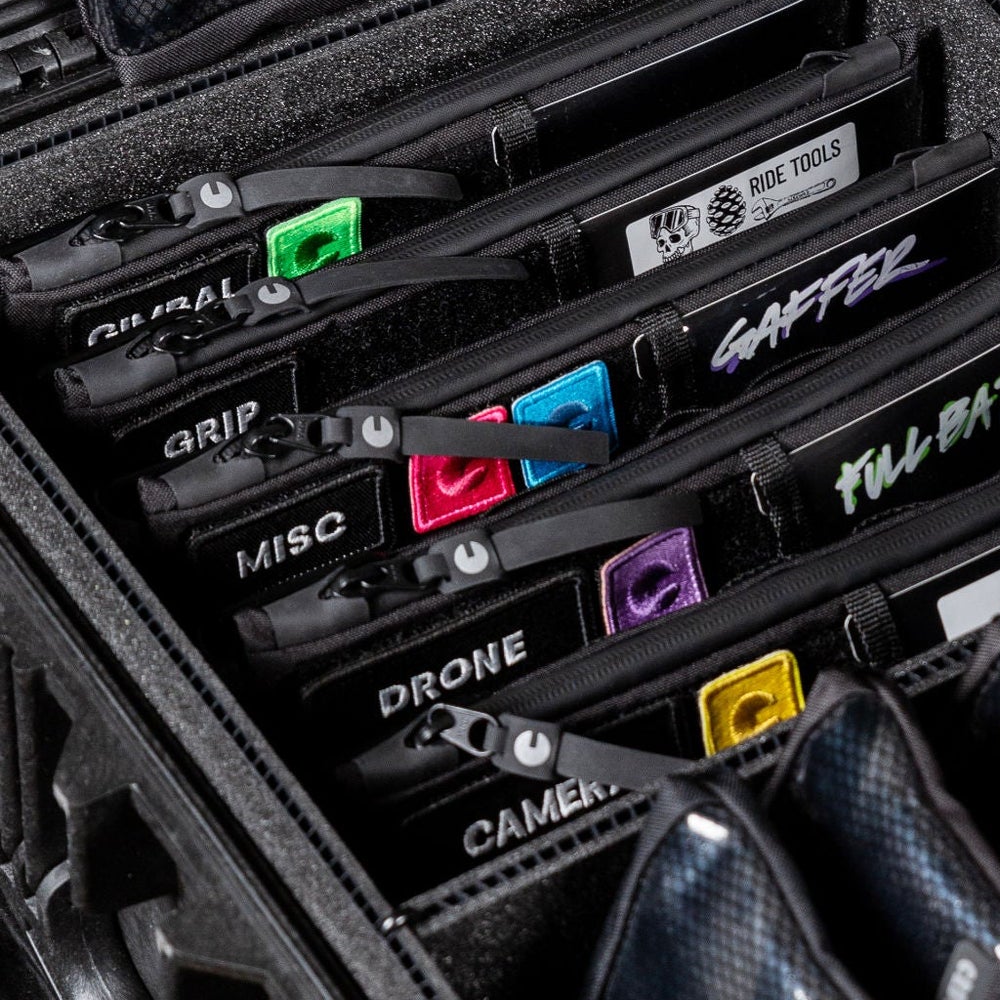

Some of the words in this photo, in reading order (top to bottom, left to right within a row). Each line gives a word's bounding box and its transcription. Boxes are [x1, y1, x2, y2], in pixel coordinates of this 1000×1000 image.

[749, 164, 788, 198] RIDE
[790, 137, 842, 178] TOOLS
[710, 234, 947, 374] GAFFER
[163, 400, 261, 460] GRIP
[834, 425, 934, 515] FULL
[236, 510, 349, 579] MISC
[377, 629, 528, 719] DRONE
[462, 776, 621, 859] CAMER
